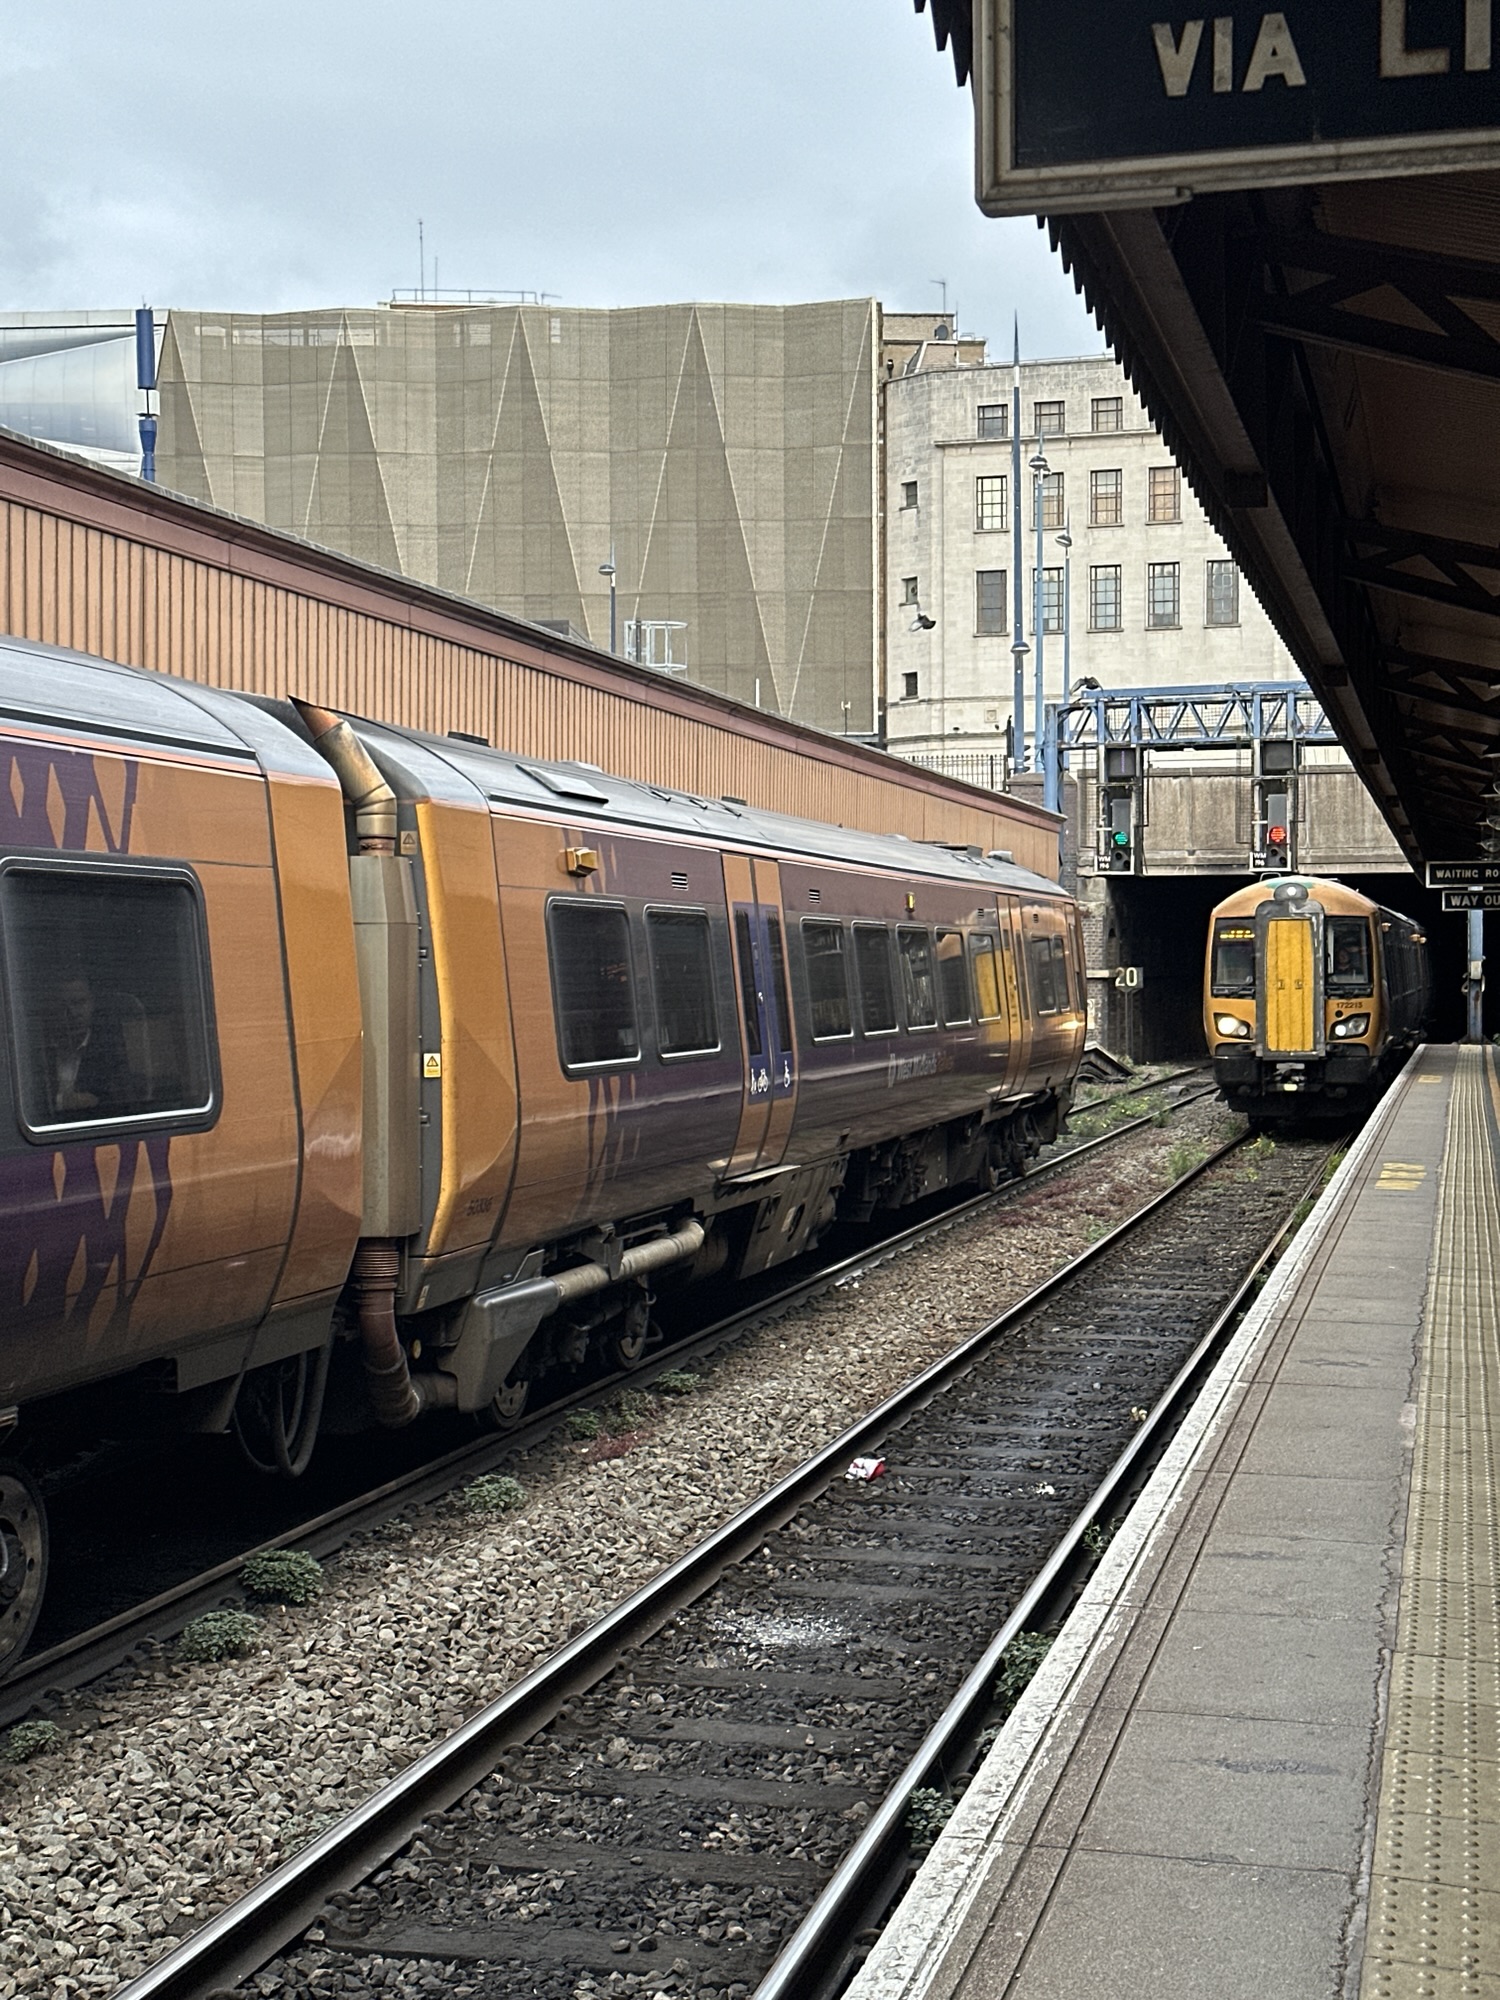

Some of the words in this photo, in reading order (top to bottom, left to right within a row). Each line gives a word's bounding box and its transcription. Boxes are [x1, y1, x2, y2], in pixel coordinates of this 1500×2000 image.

[1151, 13, 1307, 97] VIA
[1435, 869, 1479, 879] WAITING
[1450, 895, 1479, 907] WAY
[1115, 966, 1138, 987] 20
